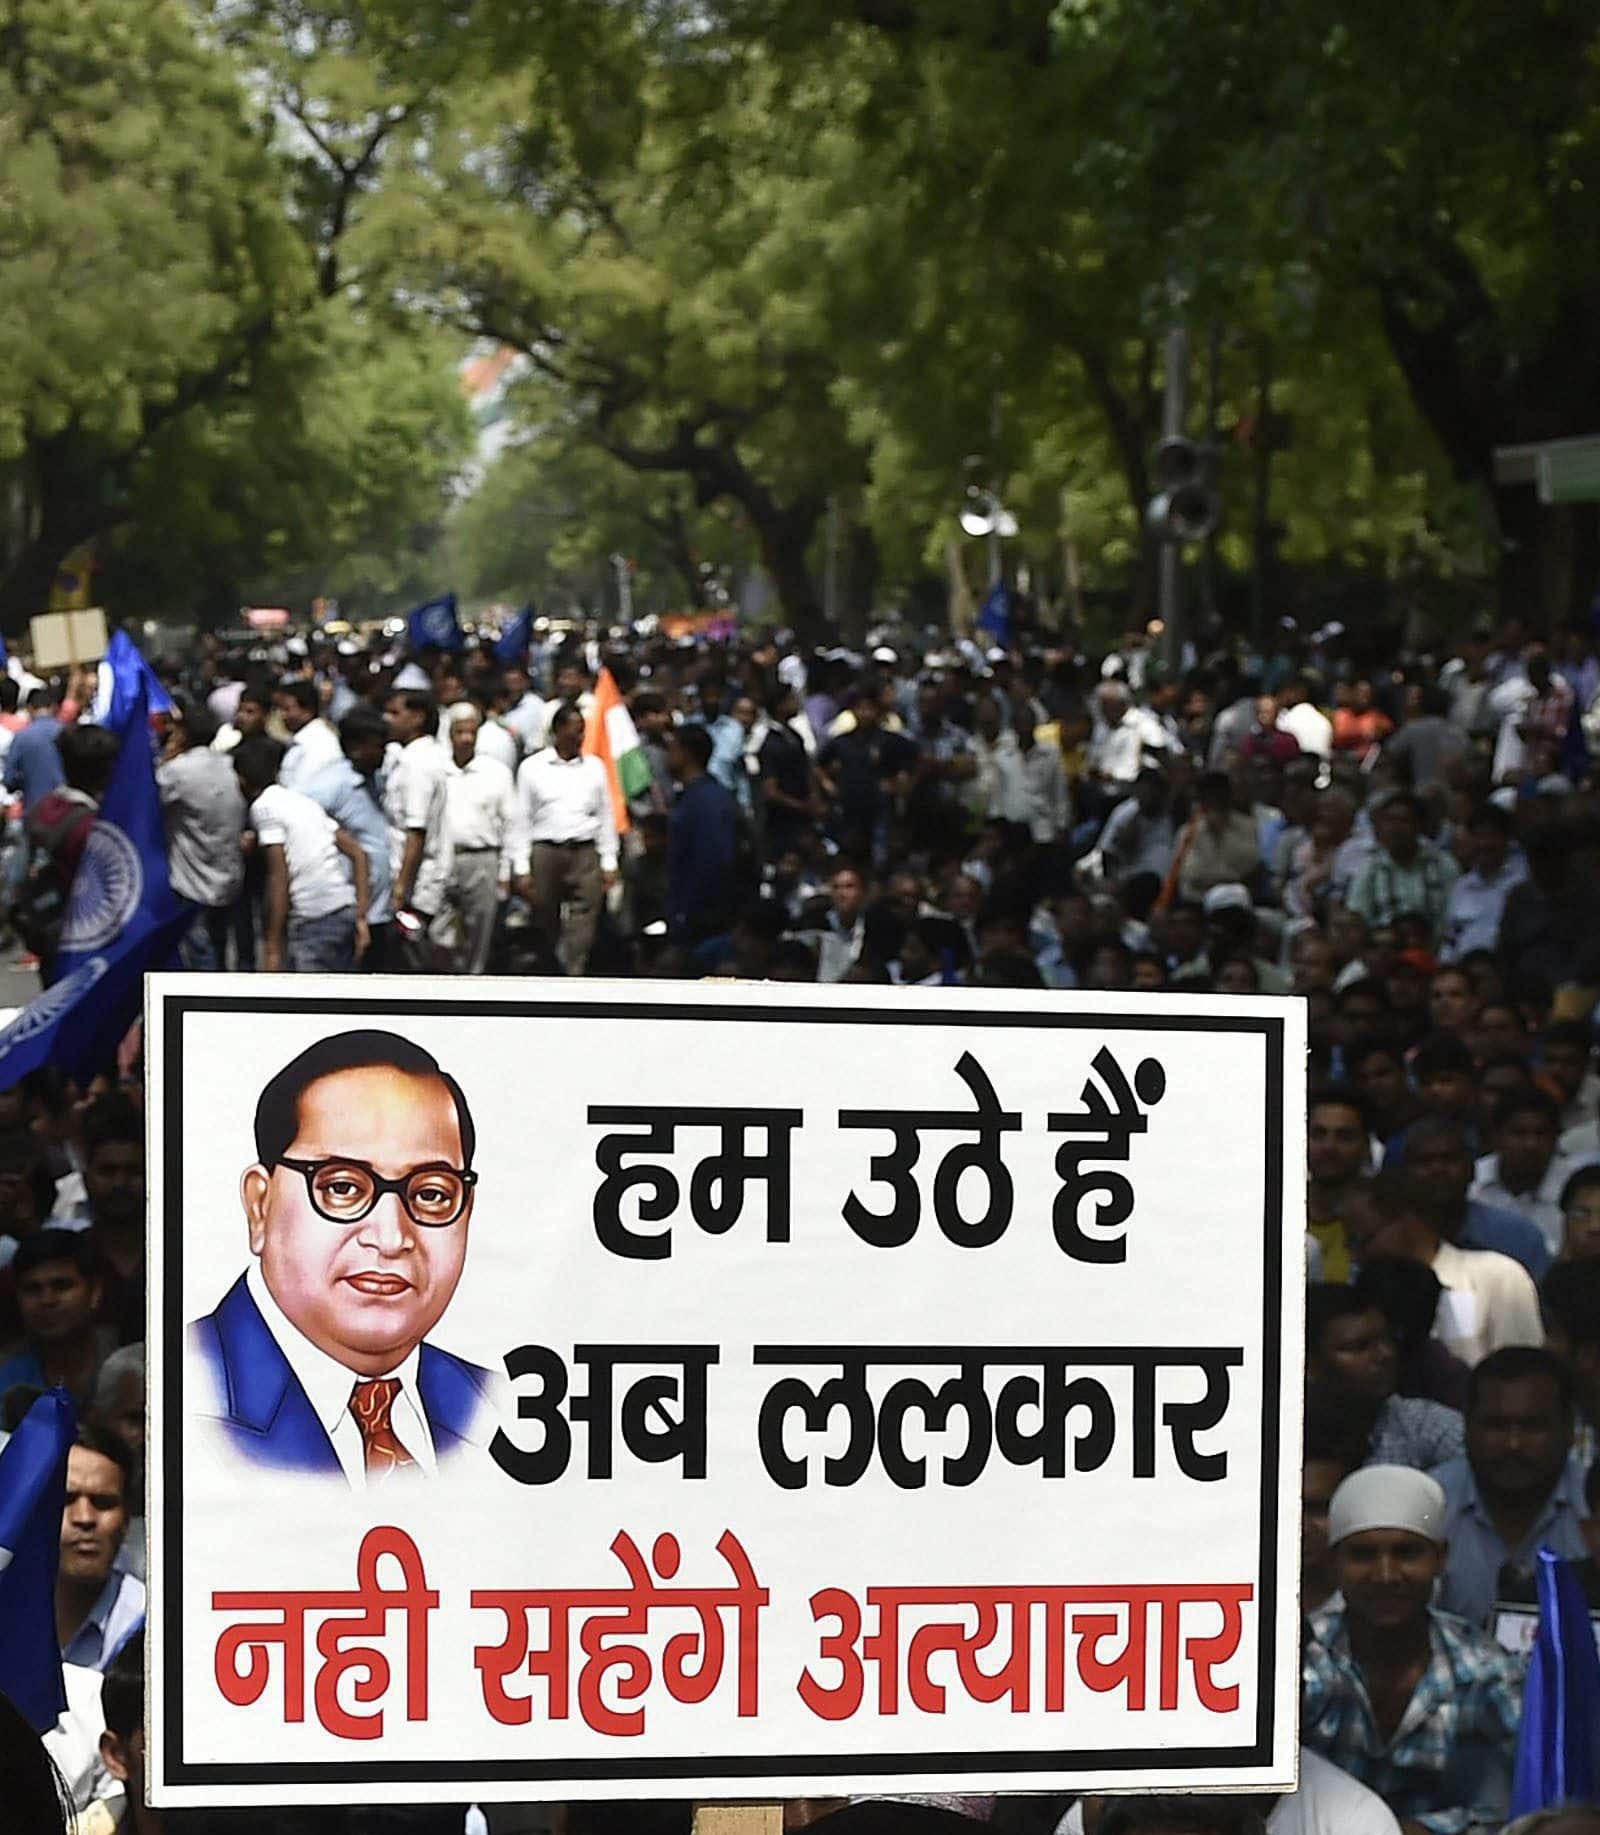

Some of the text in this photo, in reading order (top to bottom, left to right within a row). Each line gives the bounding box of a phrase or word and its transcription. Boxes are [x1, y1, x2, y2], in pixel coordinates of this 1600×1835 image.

[587, 1044, 1166, 1265] हम उठे हैं
[488, 1343, 1244, 1490] अब ललकार
[212, 1526, 1255, 1740] नही सहेंगे अत्याचार
